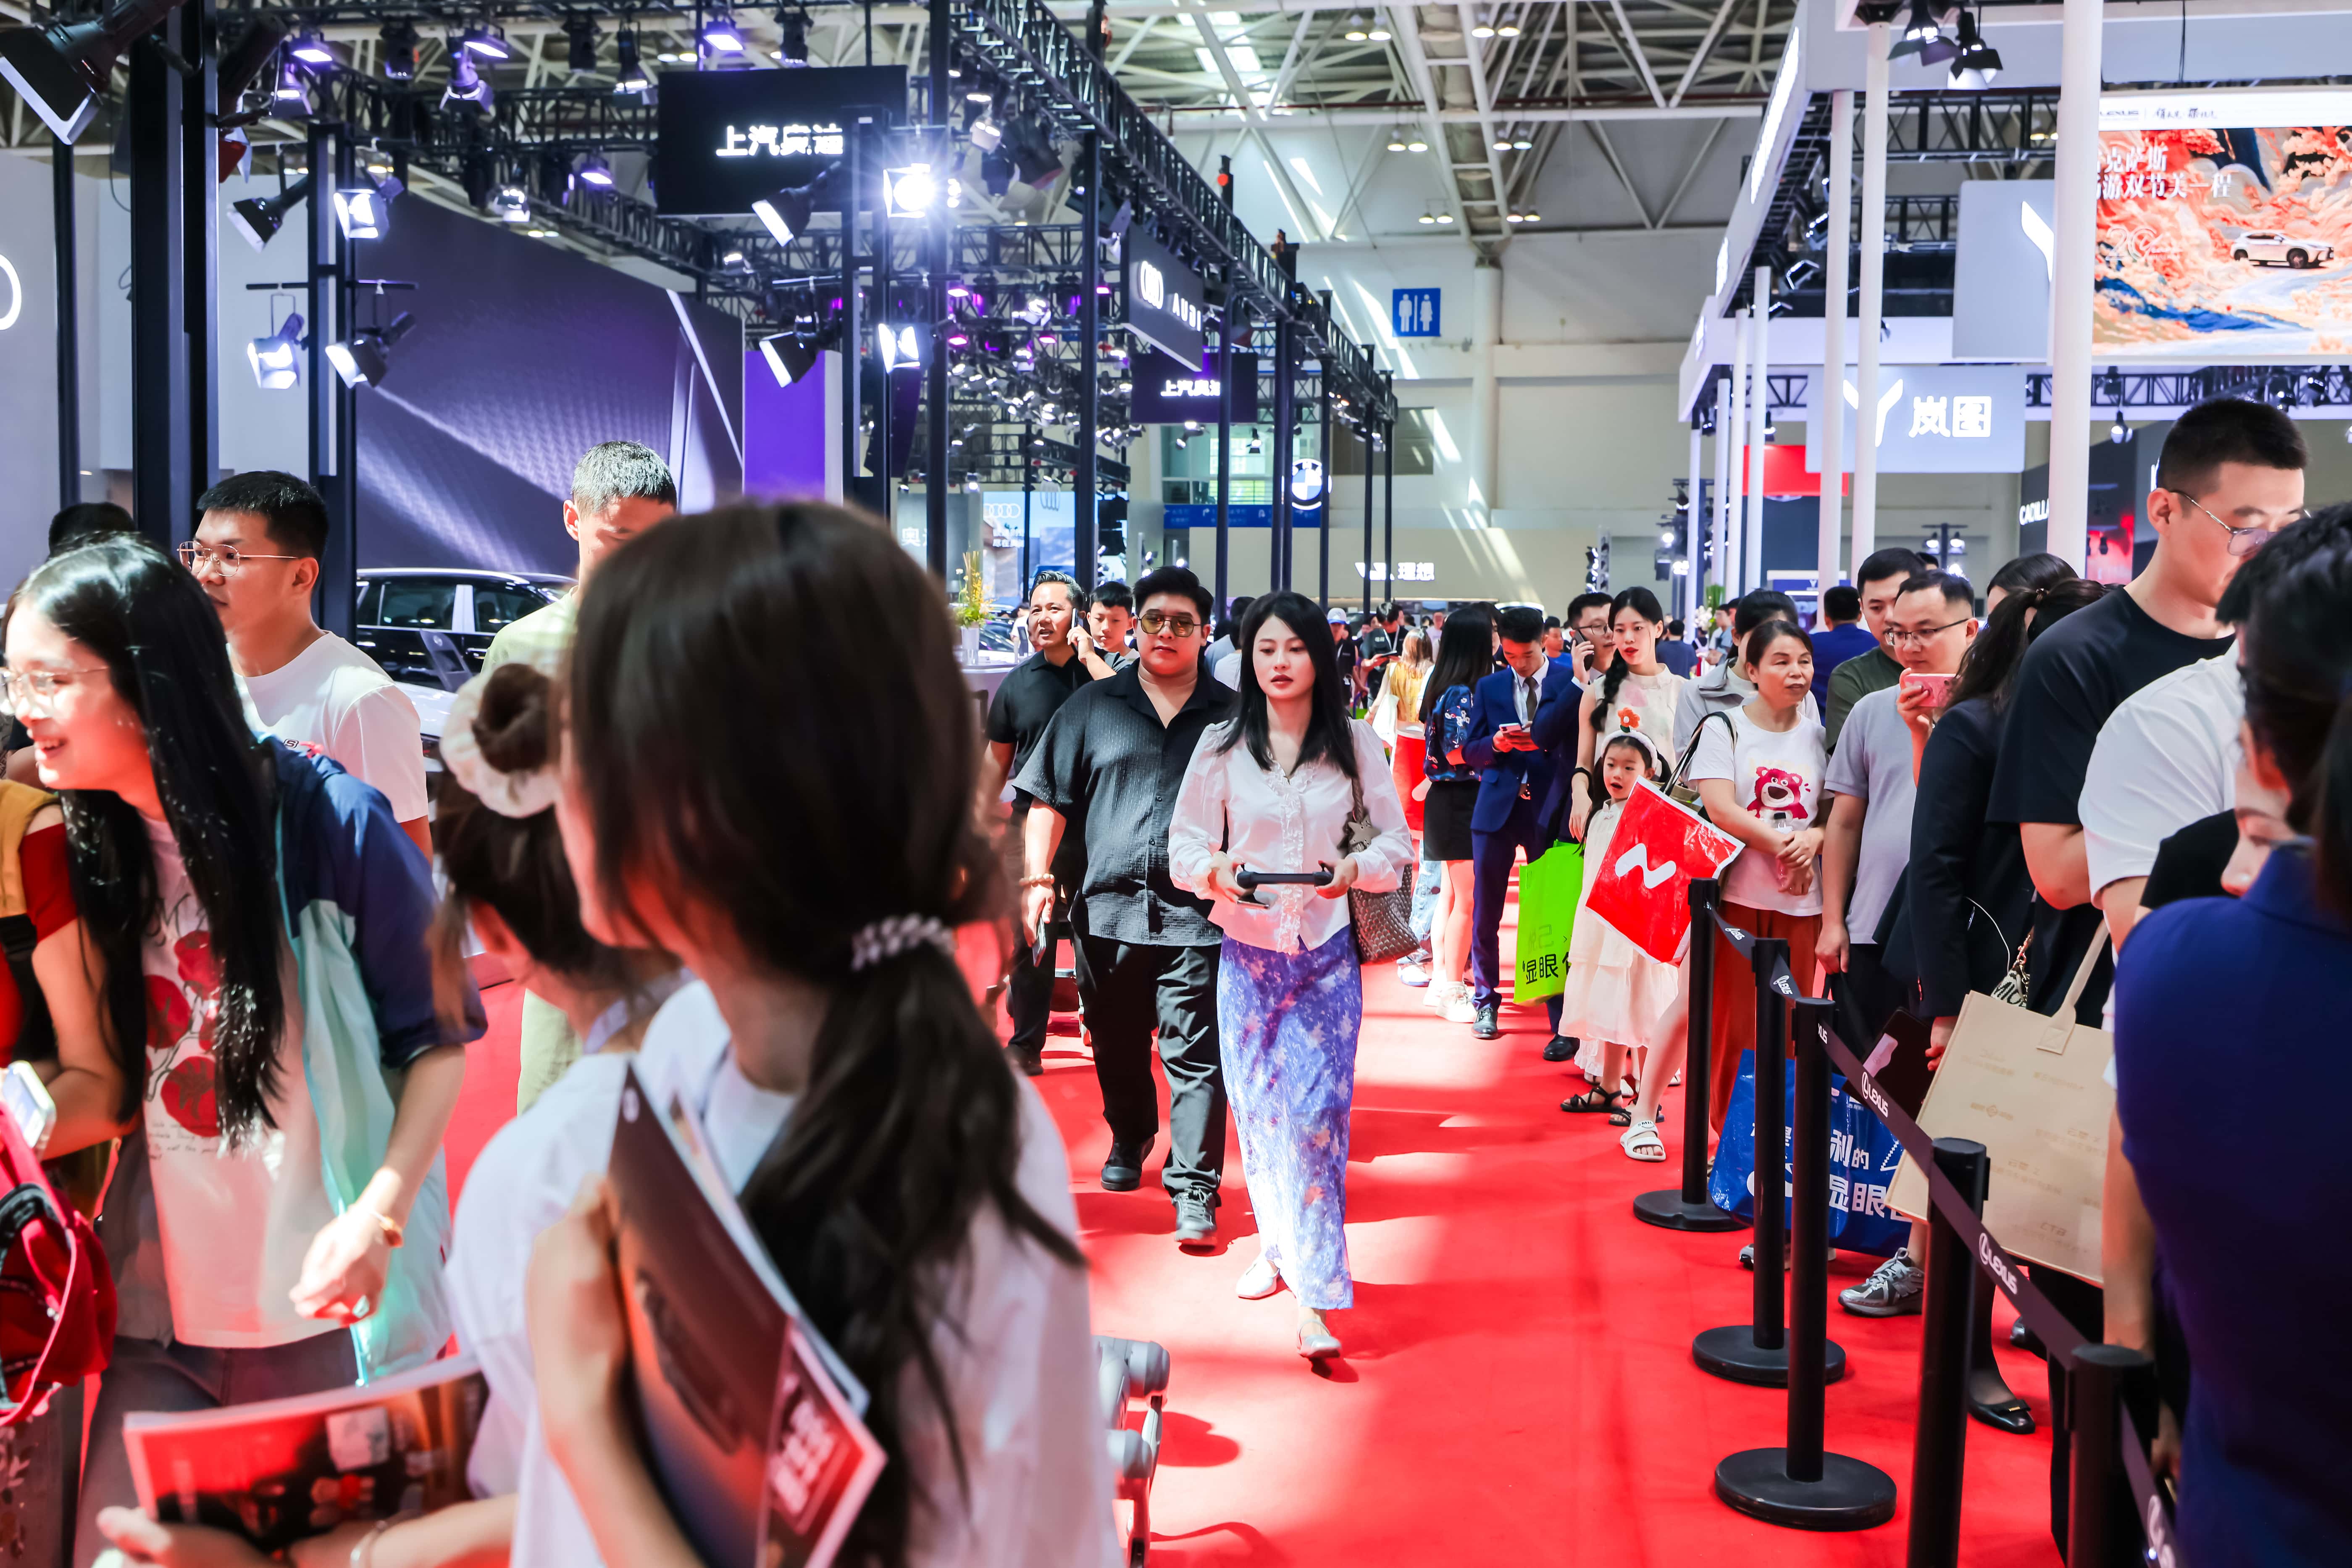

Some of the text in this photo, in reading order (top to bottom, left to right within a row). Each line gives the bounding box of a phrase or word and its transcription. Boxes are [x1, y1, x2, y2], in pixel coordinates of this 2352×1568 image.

[1908, 396, 1992, 438] 岚图
[1398, 562, 1435, 581] 理想
[1868, 1083, 1888, 1118] LEXUS
[1829, 1173, 1913, 1223] 显眼
[1988, 1248, 2018, 1295] LEXUS
